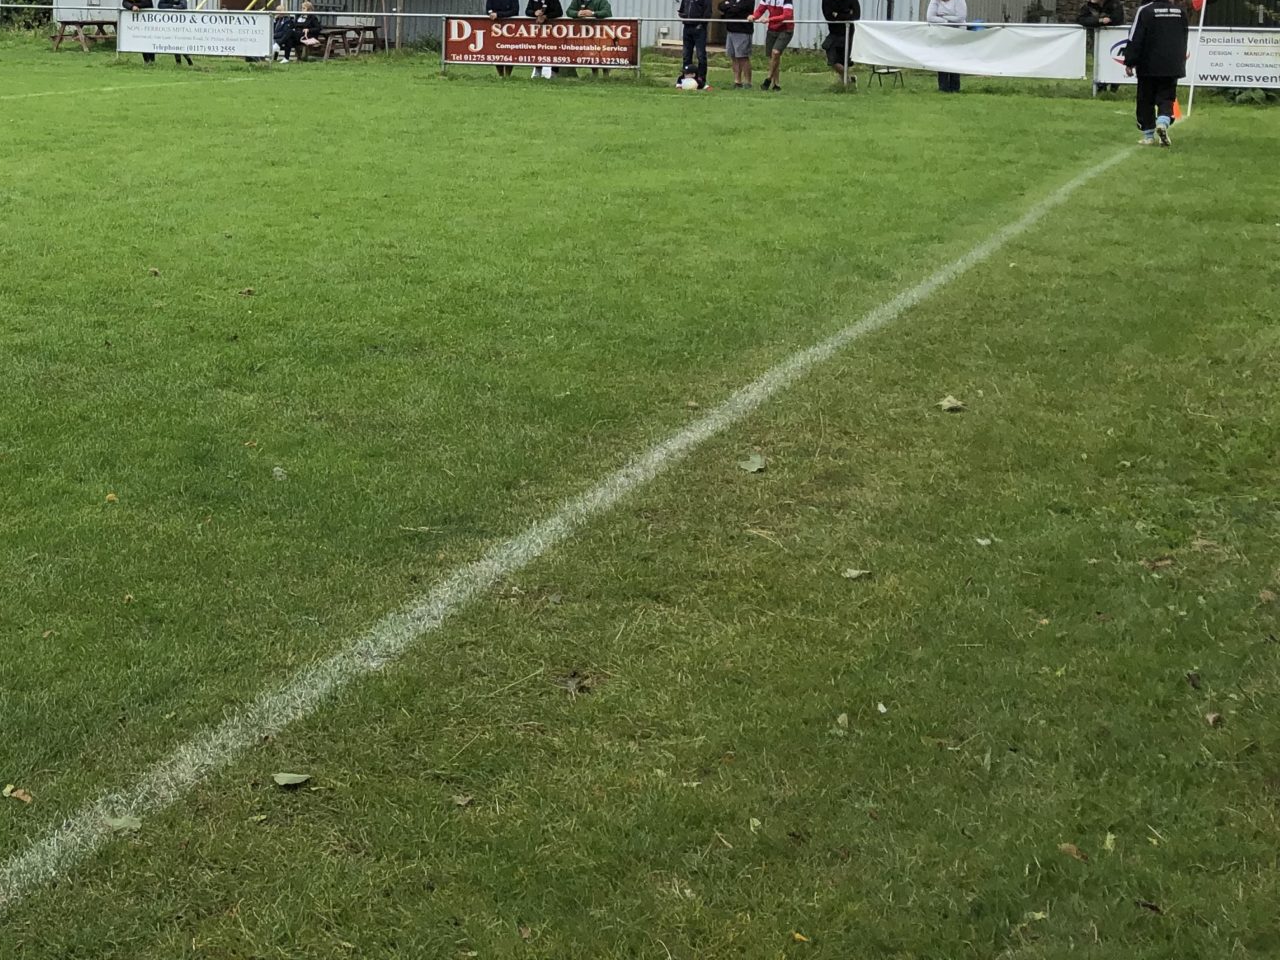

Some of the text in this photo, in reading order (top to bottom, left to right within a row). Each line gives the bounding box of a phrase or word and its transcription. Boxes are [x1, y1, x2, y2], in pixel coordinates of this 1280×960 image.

[132, 13, 258, 25] HABGOOD & COMPANY
[491, 23, 632, 39] SCAFFOLDING
[1199, 36, 1280, 45] Specialist Ventila
[495, 42, 536, 50] Competitive
[602, 44, 628, 52] Service
[451, 53, 463, 61] Tel
[486, 54, 513, 62] 839764
[553, 56, 571, 64] 8593
